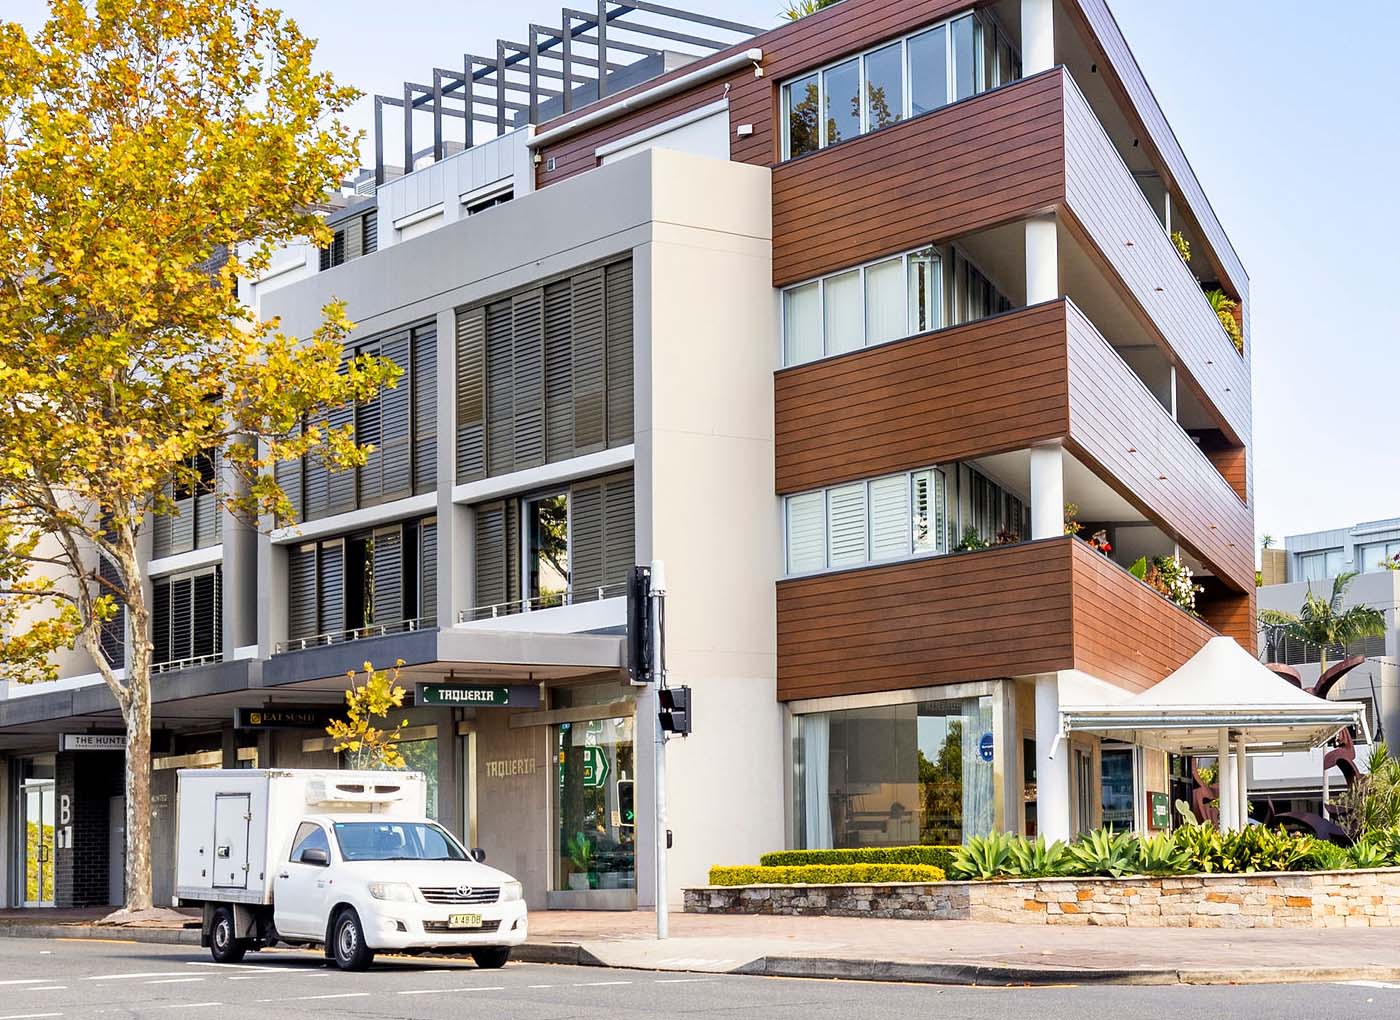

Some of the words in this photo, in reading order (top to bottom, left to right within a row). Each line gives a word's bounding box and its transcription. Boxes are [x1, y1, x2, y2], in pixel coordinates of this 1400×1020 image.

[438, 689, 494, 702] TAQUERIA
[75, 736, 93, 745] THE
[485, 758, 536, 779] TAQUERIA
